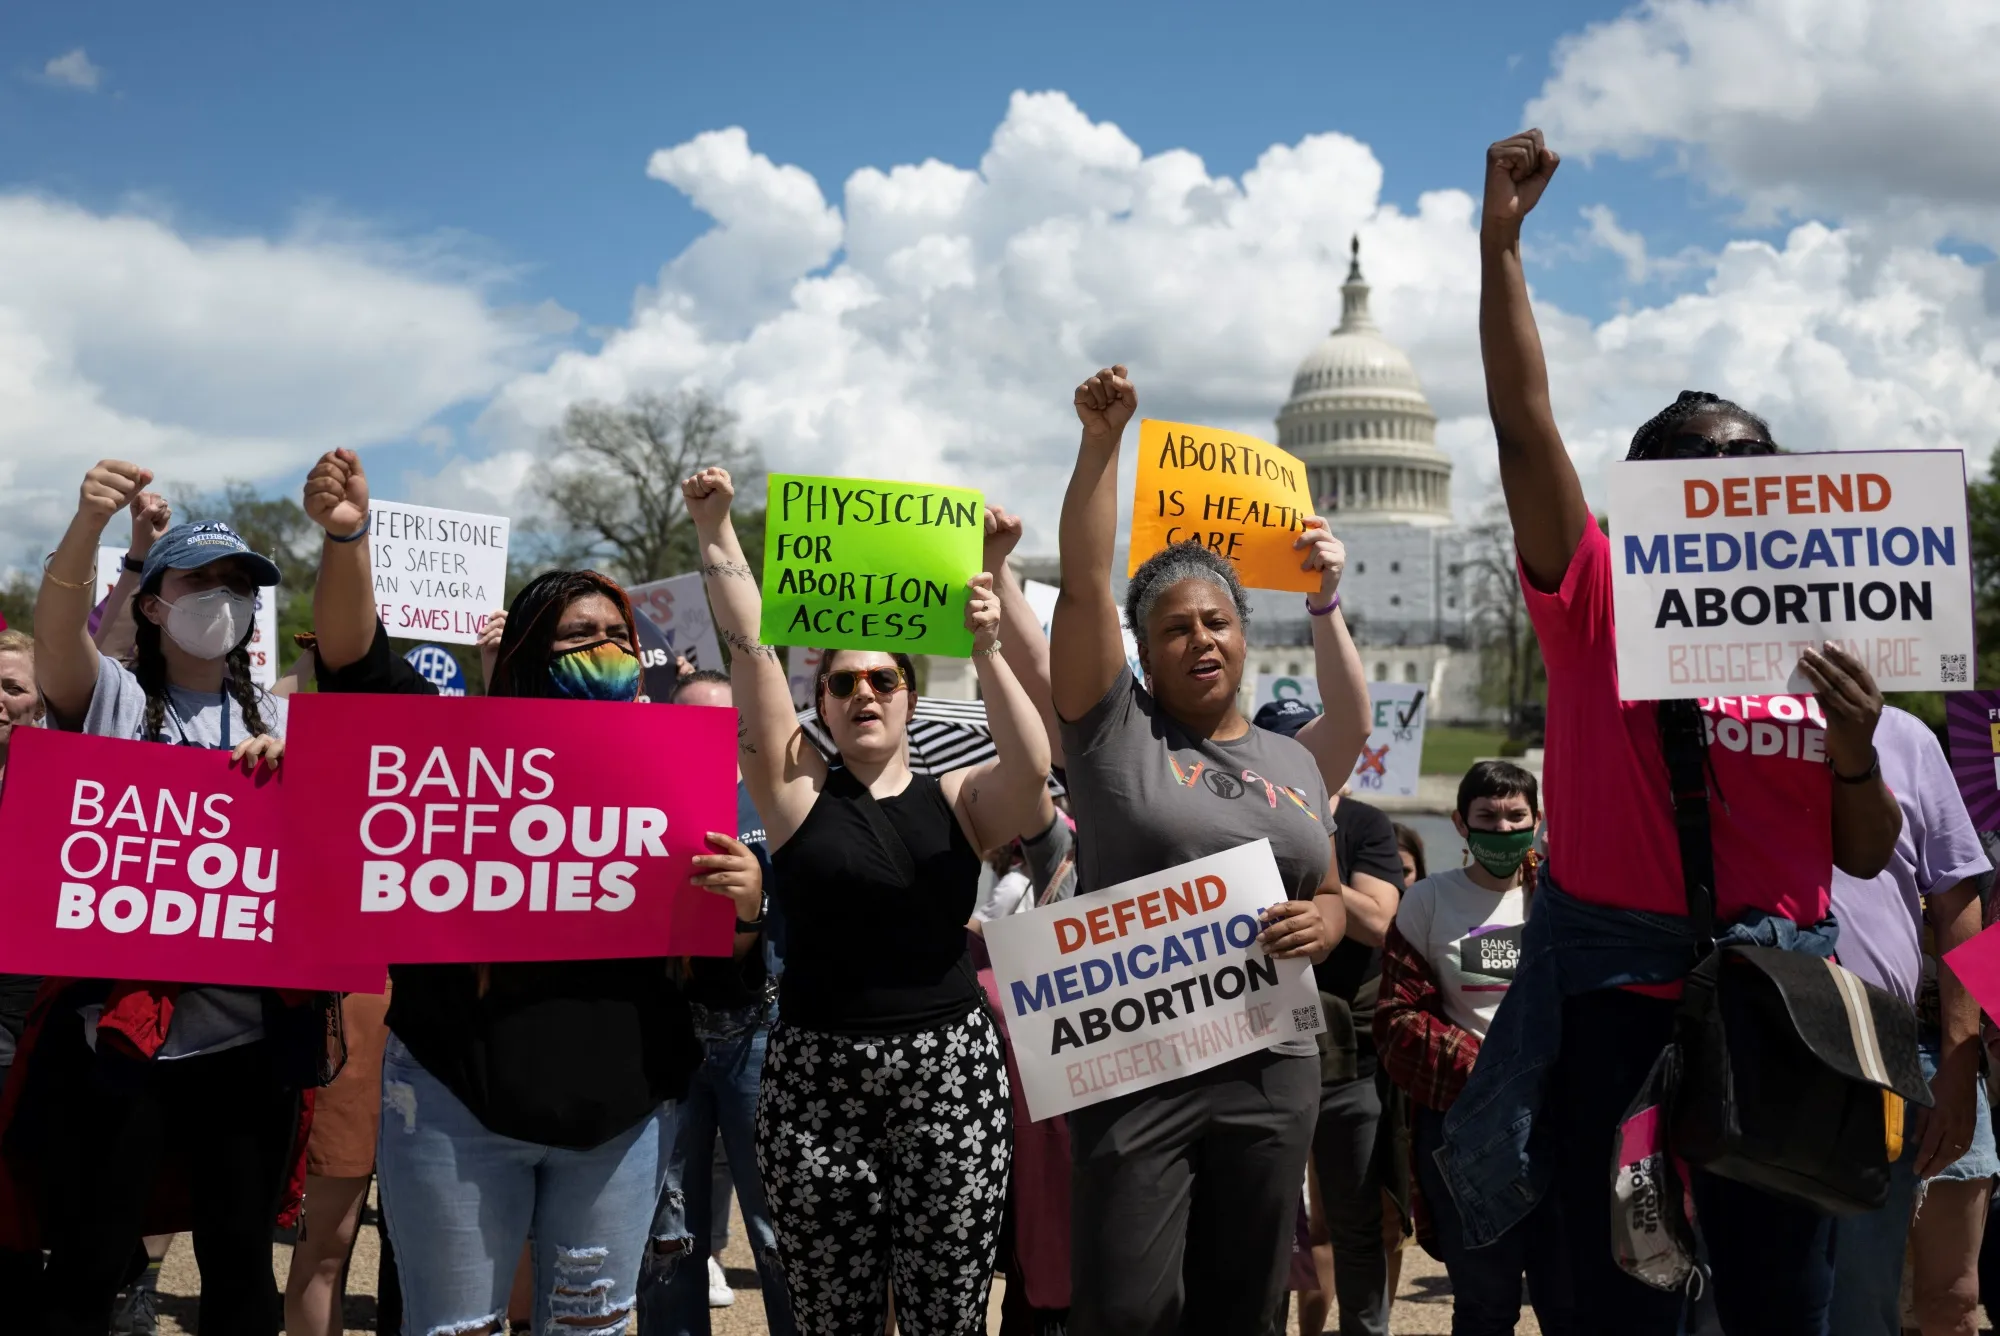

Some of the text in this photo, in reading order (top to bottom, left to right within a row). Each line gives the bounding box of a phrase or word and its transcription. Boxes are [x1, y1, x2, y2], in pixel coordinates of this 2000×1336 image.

[1159, 431, 1297, 492] ABORTION
[783, 481, 977, 528] PHYSICIAN
[1158, 490, 1307, 532] IS HEALTH
[1683, 473, 1892, 519] DEFEND
[375, 544, 469, 576] IS SAFER
[777, 533, 832, 563] FOR
[1624, 526, 1956, 575] MEDICATION
[374, 574, 487, 602] AN VIAGRA
[777, 568, 948, 608] ABORTION
[1655, 581, 1932, 628] ABORTION
[398, 604, 450, 631] SAVES
[454, 610, 490, 634] LIVE
[787, 604, 927, 640] ACCESS
[1668, 636, 1921, 684] BIGGER TN ROE
[368, 745, 555, 800] BANS
[70, 779, 233, 839] BANS
[359, 802, 669, 857] OFF OUR
[60, 831, 181, 884] OFF
[360, 859, 639, 913] BODIES
[1053, 874, 1227, 955] DEFEND
[1480, 938, 1514, 950] BANS
[1480, 948, 1505, 959] OFF
[1482, 958, 1519, 969] BODI
[1051, 954, 1279, 1056] ABORTION
[1065, 1001, 1278, 1098] BIGGER THAN ROE
